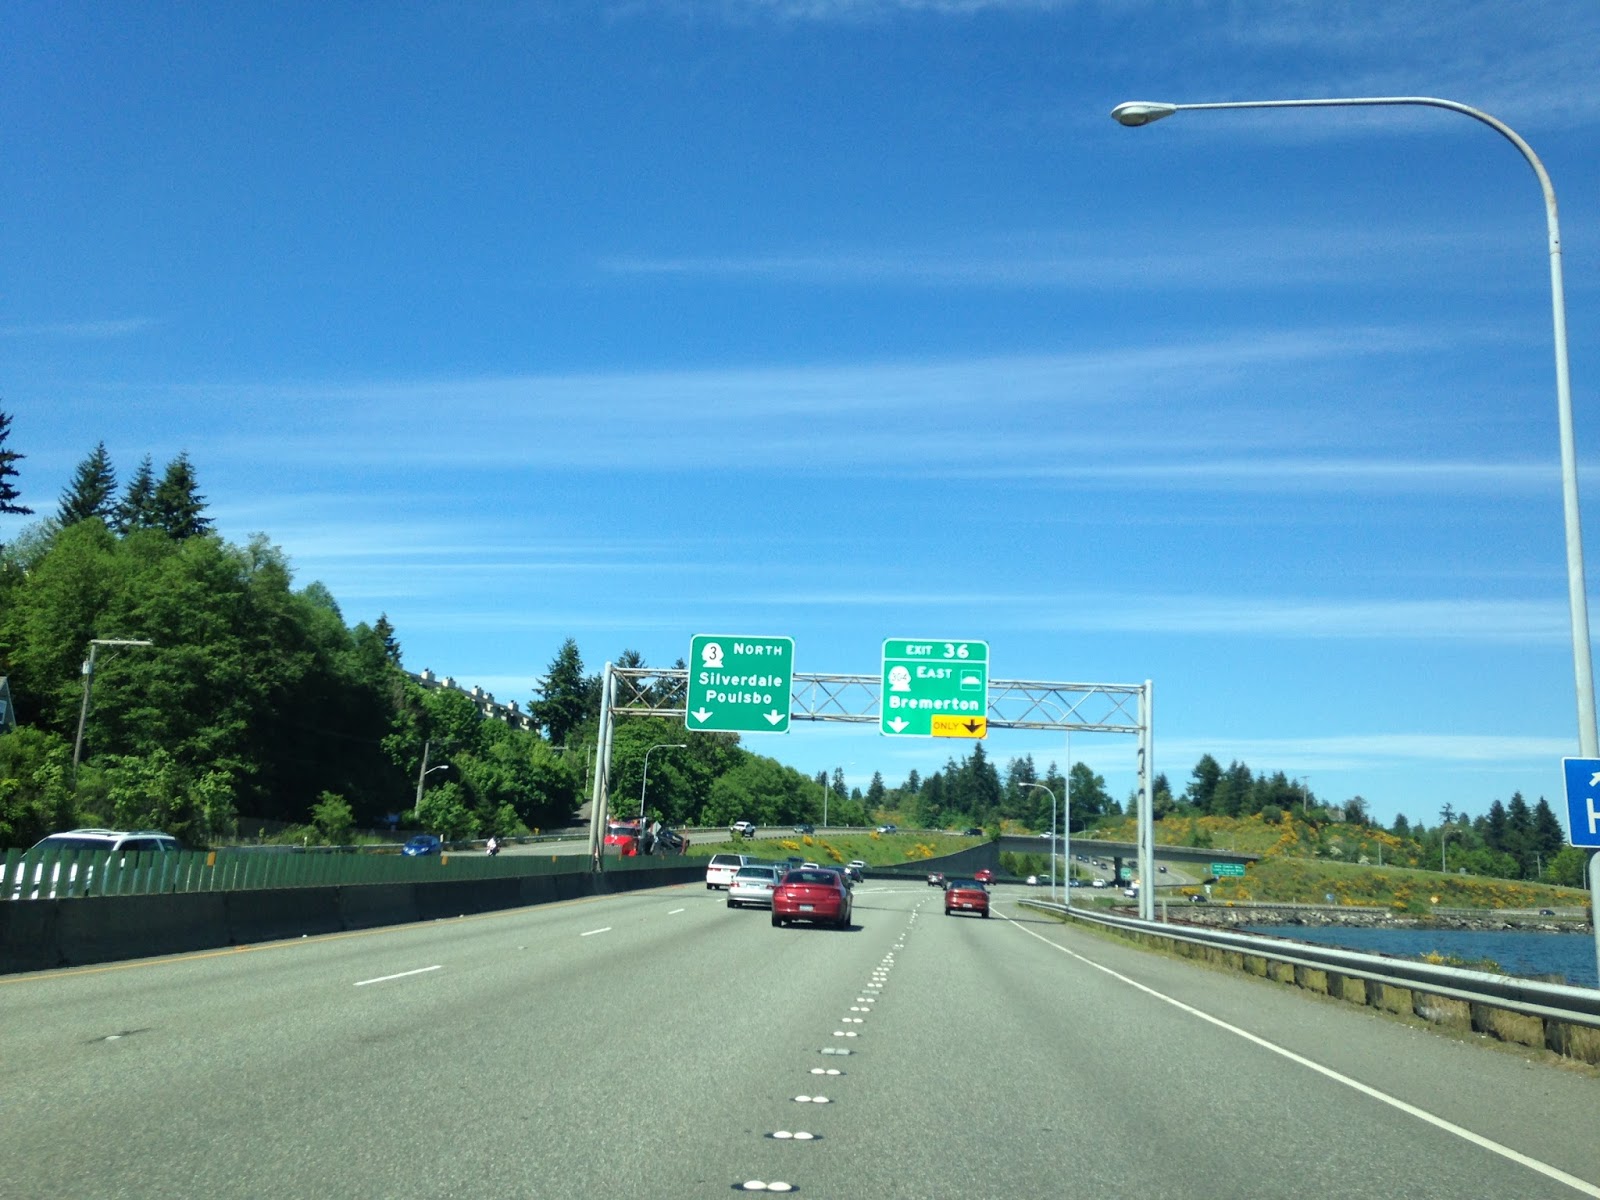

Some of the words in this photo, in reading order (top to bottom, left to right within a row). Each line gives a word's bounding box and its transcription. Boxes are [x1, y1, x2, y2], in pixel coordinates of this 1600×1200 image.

[709, 646, 717, 660] 3
[733, 643, 782, 656] NORTH
[905, 644, 933, 655] EXIT
[943, 643, 969, 659] 36
[698, 672, 783, 687] Silverdale
[916, 665, 953, 679] EAST
[705, 690, 772, 704] Poulsbo
[888, 695, 979, 711] Bremerton
[933, 722, 959, 730] ONLY
